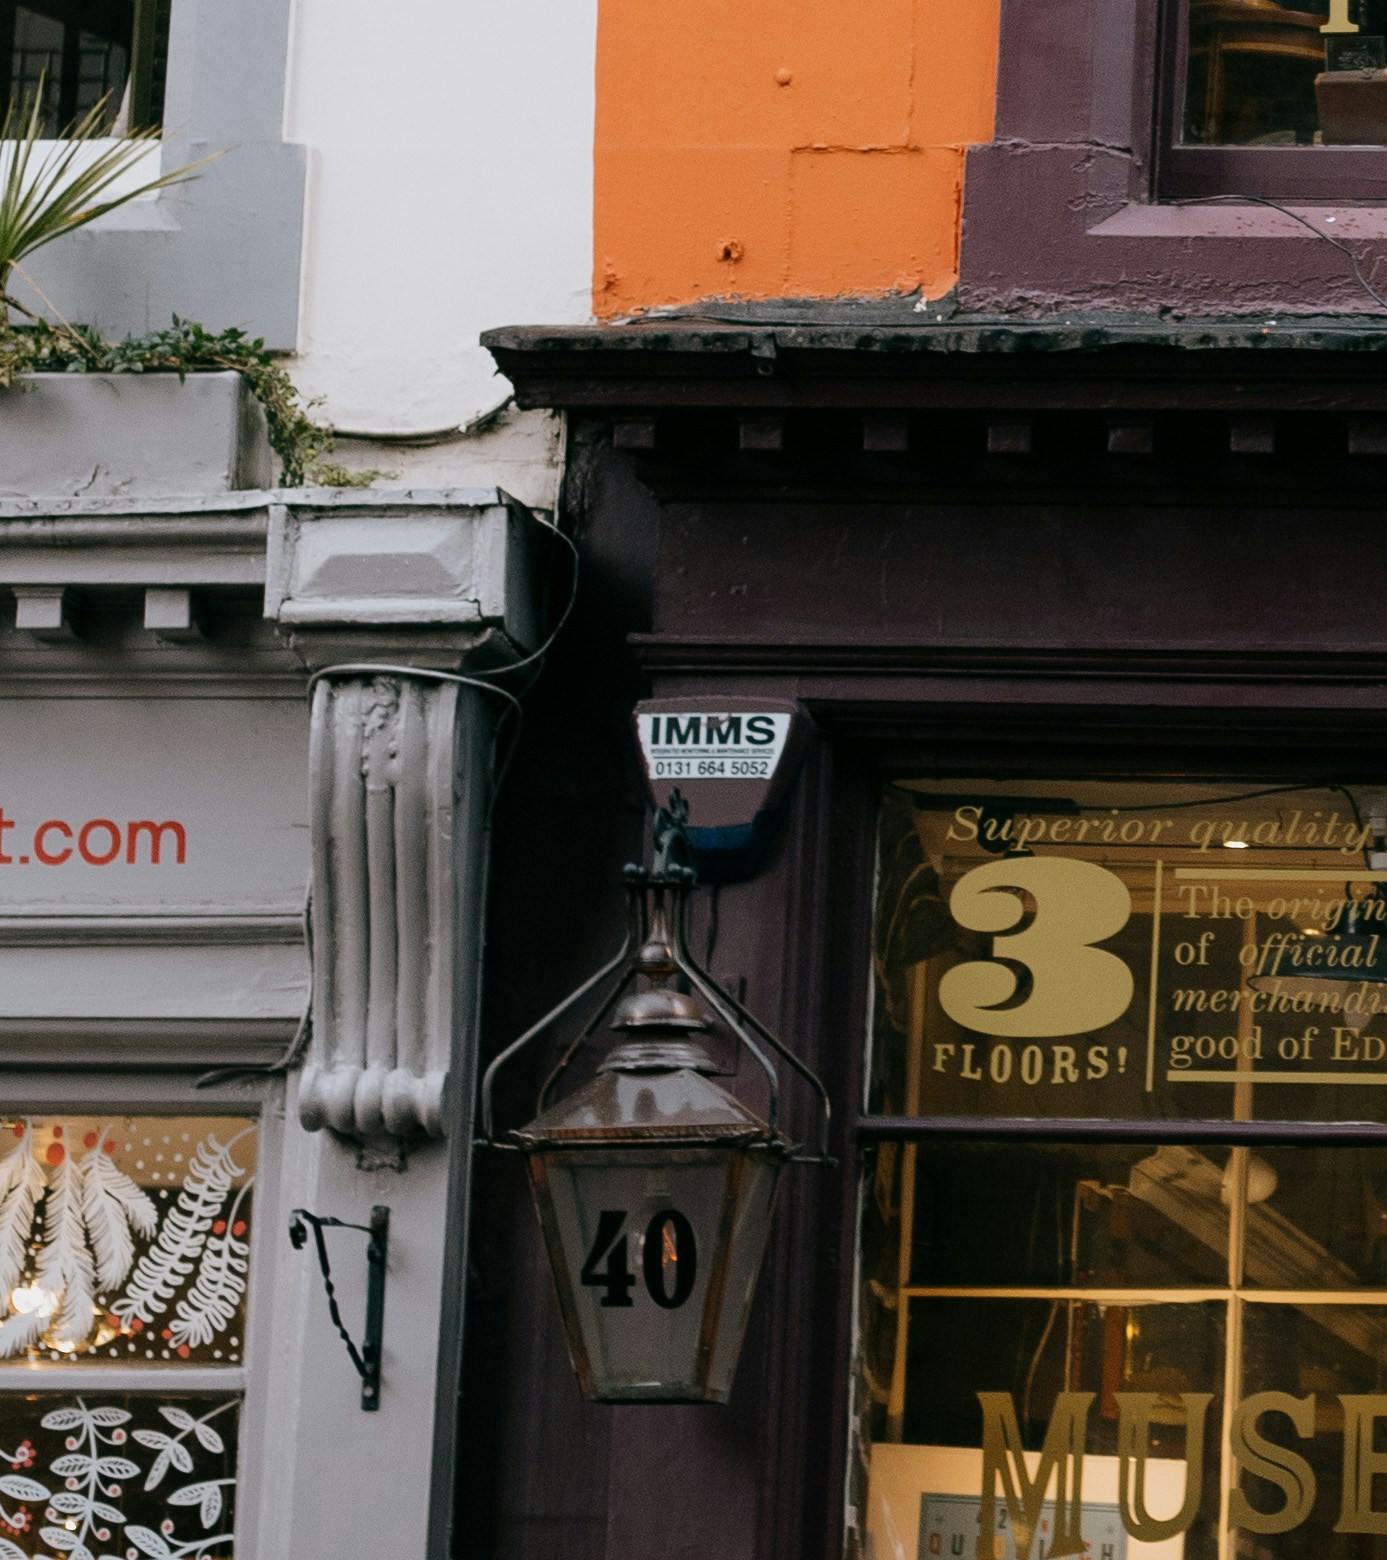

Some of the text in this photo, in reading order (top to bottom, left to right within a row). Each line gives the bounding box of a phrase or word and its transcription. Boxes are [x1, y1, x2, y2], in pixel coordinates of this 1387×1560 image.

[652, 716, 775, 745] IMMS
[656, 762, 768, 775] 0131 664 5052
[946, 806, 1174, 852] Superior
[1190, 811, 1371, 855] quality
[1179, 885, 1253, 920] The
[939, 856, 1134, 1037] 3
[1175, 933, 1215, 966] of
[1239, 932, 1378, 975] official
[933, 1044, 1128, 1085] FLOORS!
[1170, 1027, 1262, 1067] good
[1278, 1027, 1314, 1060] of
[580, 1210, 697, 1309] 40
